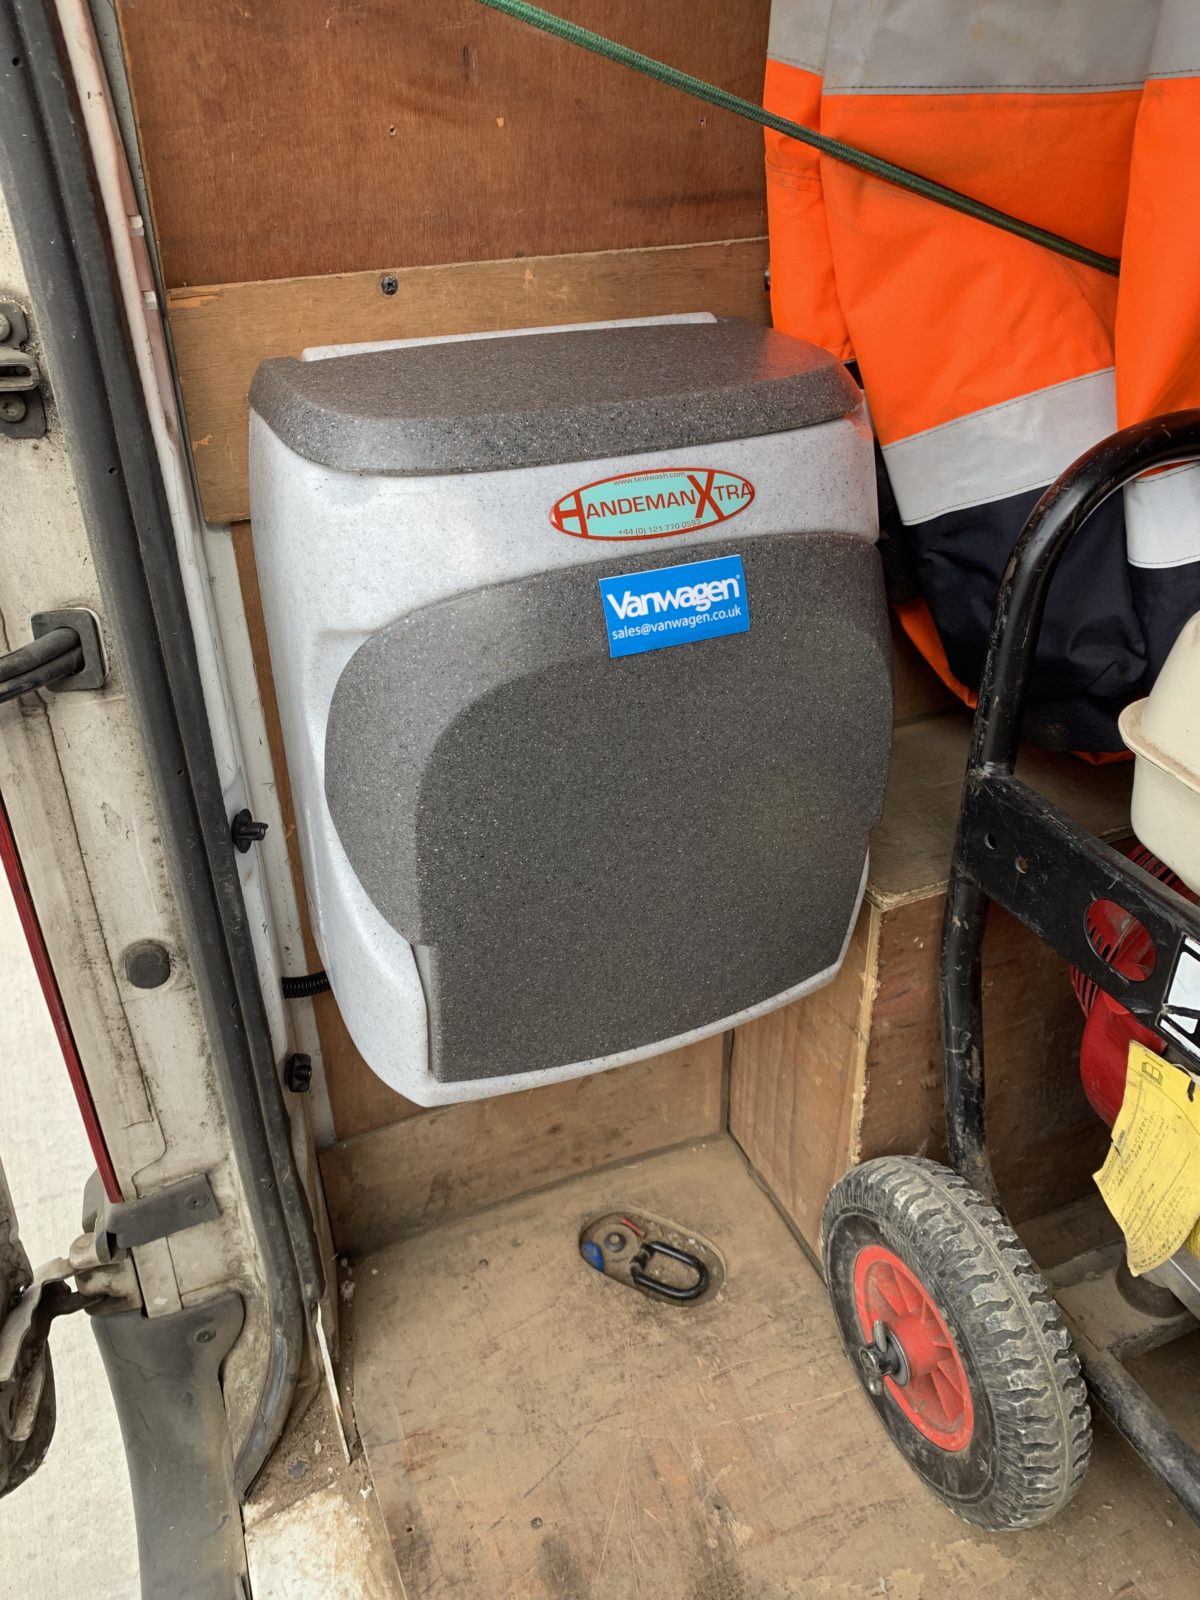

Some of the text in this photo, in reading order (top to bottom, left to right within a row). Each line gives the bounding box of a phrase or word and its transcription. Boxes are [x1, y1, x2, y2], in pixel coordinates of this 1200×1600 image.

[613, 471, 686, 486] www.tealwash.com
[618, 527, 634, 536] +44
[635, 526, 646, 536] (0)
[649, 525, 663, 534] 121
[665, 522, 680, 532] 770
[606, 577, 741, 620] Vanwagen
[612, 604, 742, 640] sales@vanwagen.co.uk
